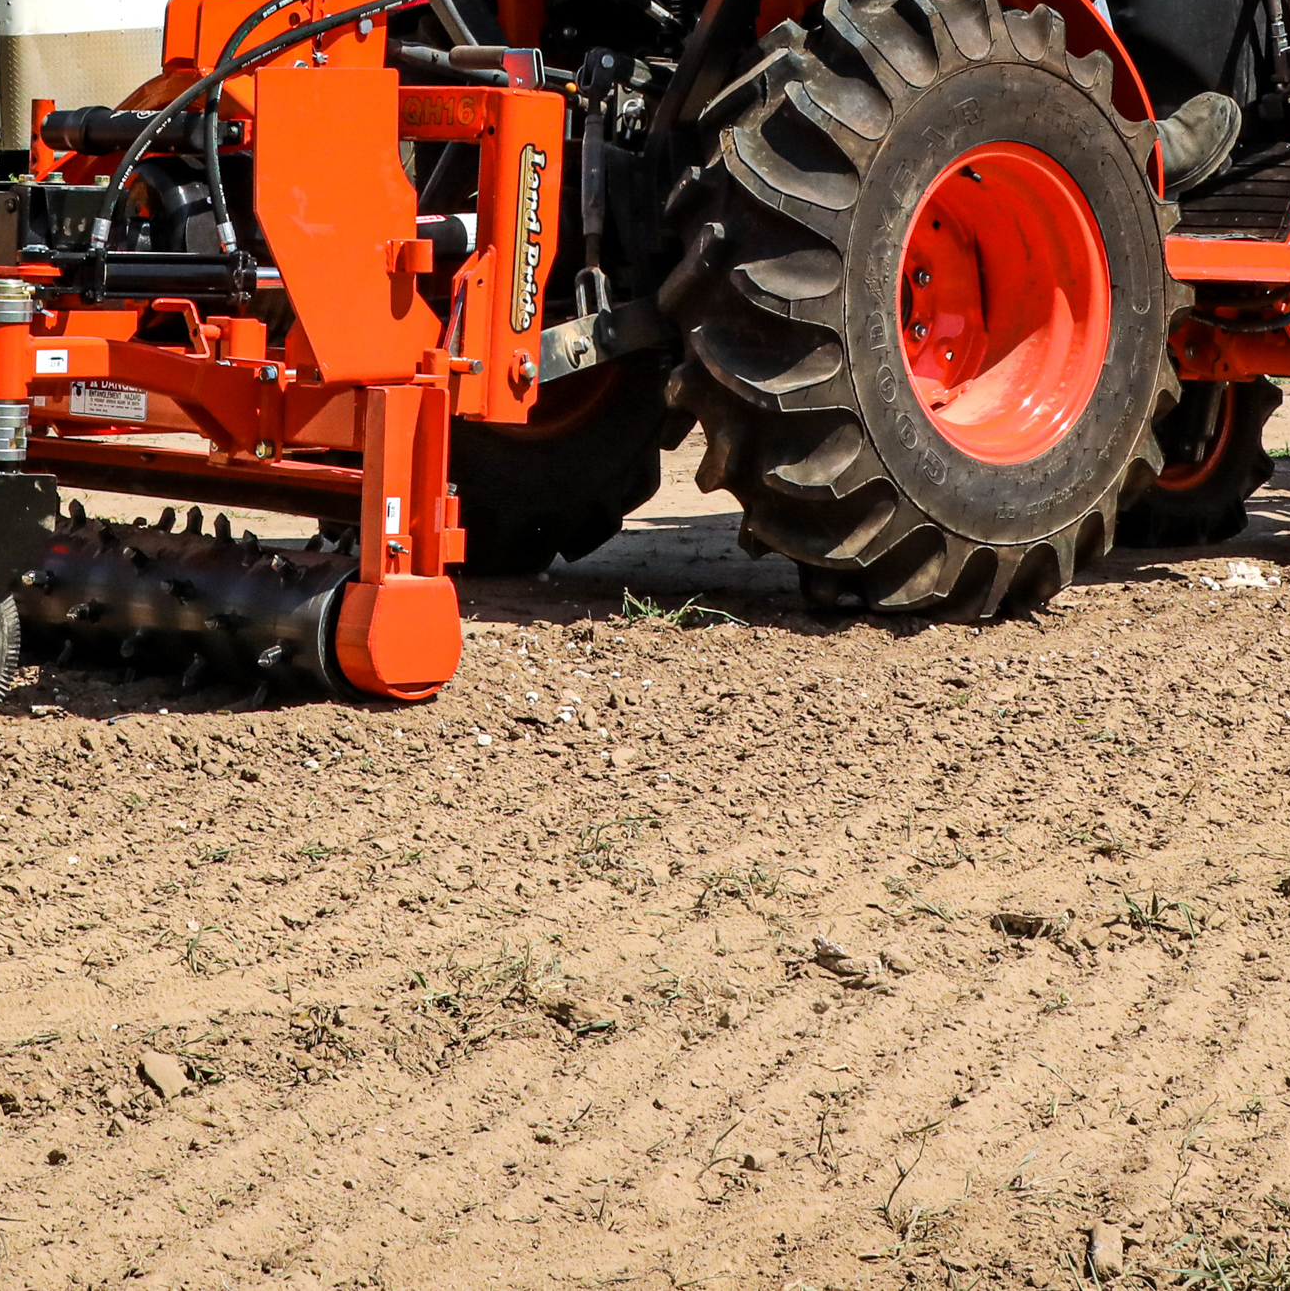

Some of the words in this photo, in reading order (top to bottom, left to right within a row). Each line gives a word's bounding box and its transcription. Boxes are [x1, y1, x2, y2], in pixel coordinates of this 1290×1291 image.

[403, 96, 476, 126] QH16
[525, 148, 546, 235] Land
[518, 241, 541, 331] Pride
[101, 381, 142, 392] DANG
